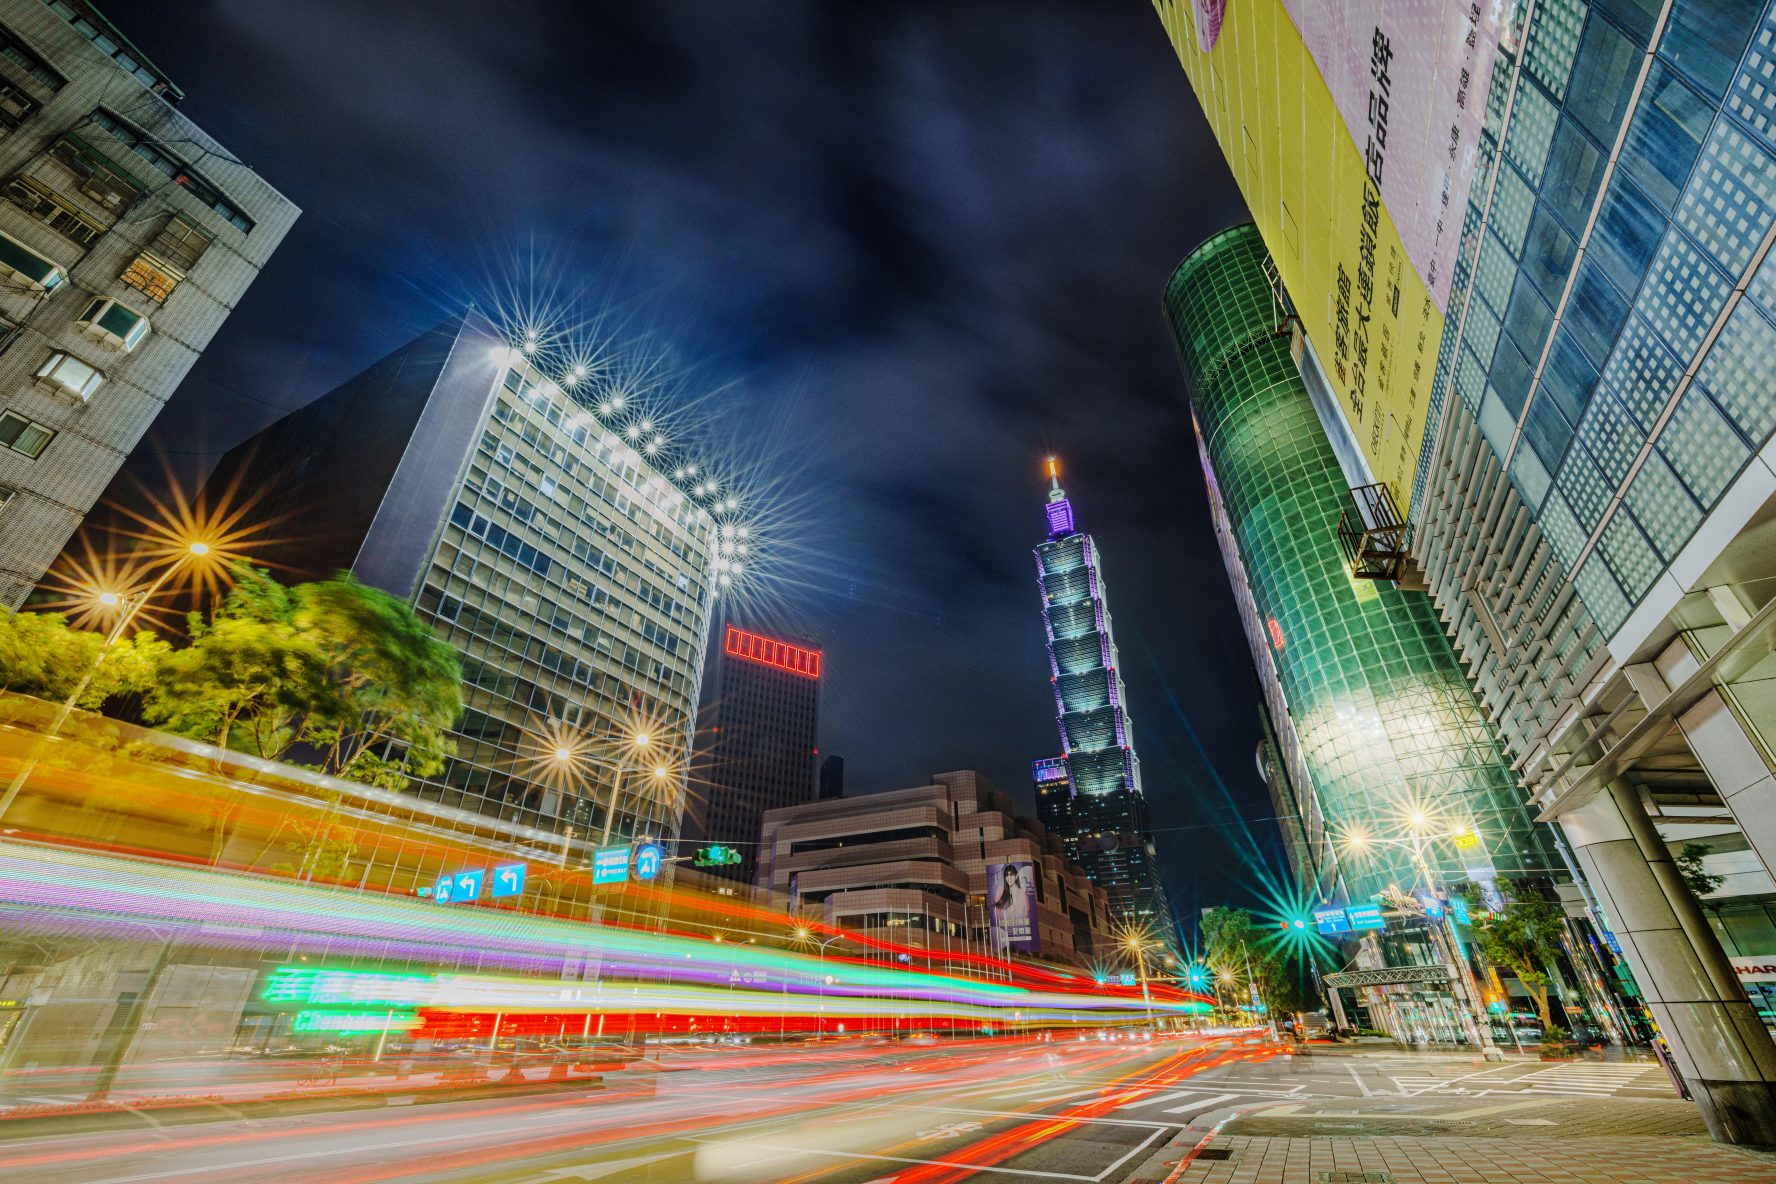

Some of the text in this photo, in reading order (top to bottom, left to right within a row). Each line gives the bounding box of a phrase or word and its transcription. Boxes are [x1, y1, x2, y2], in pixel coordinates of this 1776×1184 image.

[1448, 123, 1460, 162] 永康
[1457, 66, 1470, 110] 高雄
[1350, 25, 1394, 425] 全台最大連鎖飯店品牌
[1334, 261, 1352, 387] 雀客旅館
[1735, 964, 1776, 974] HAR
